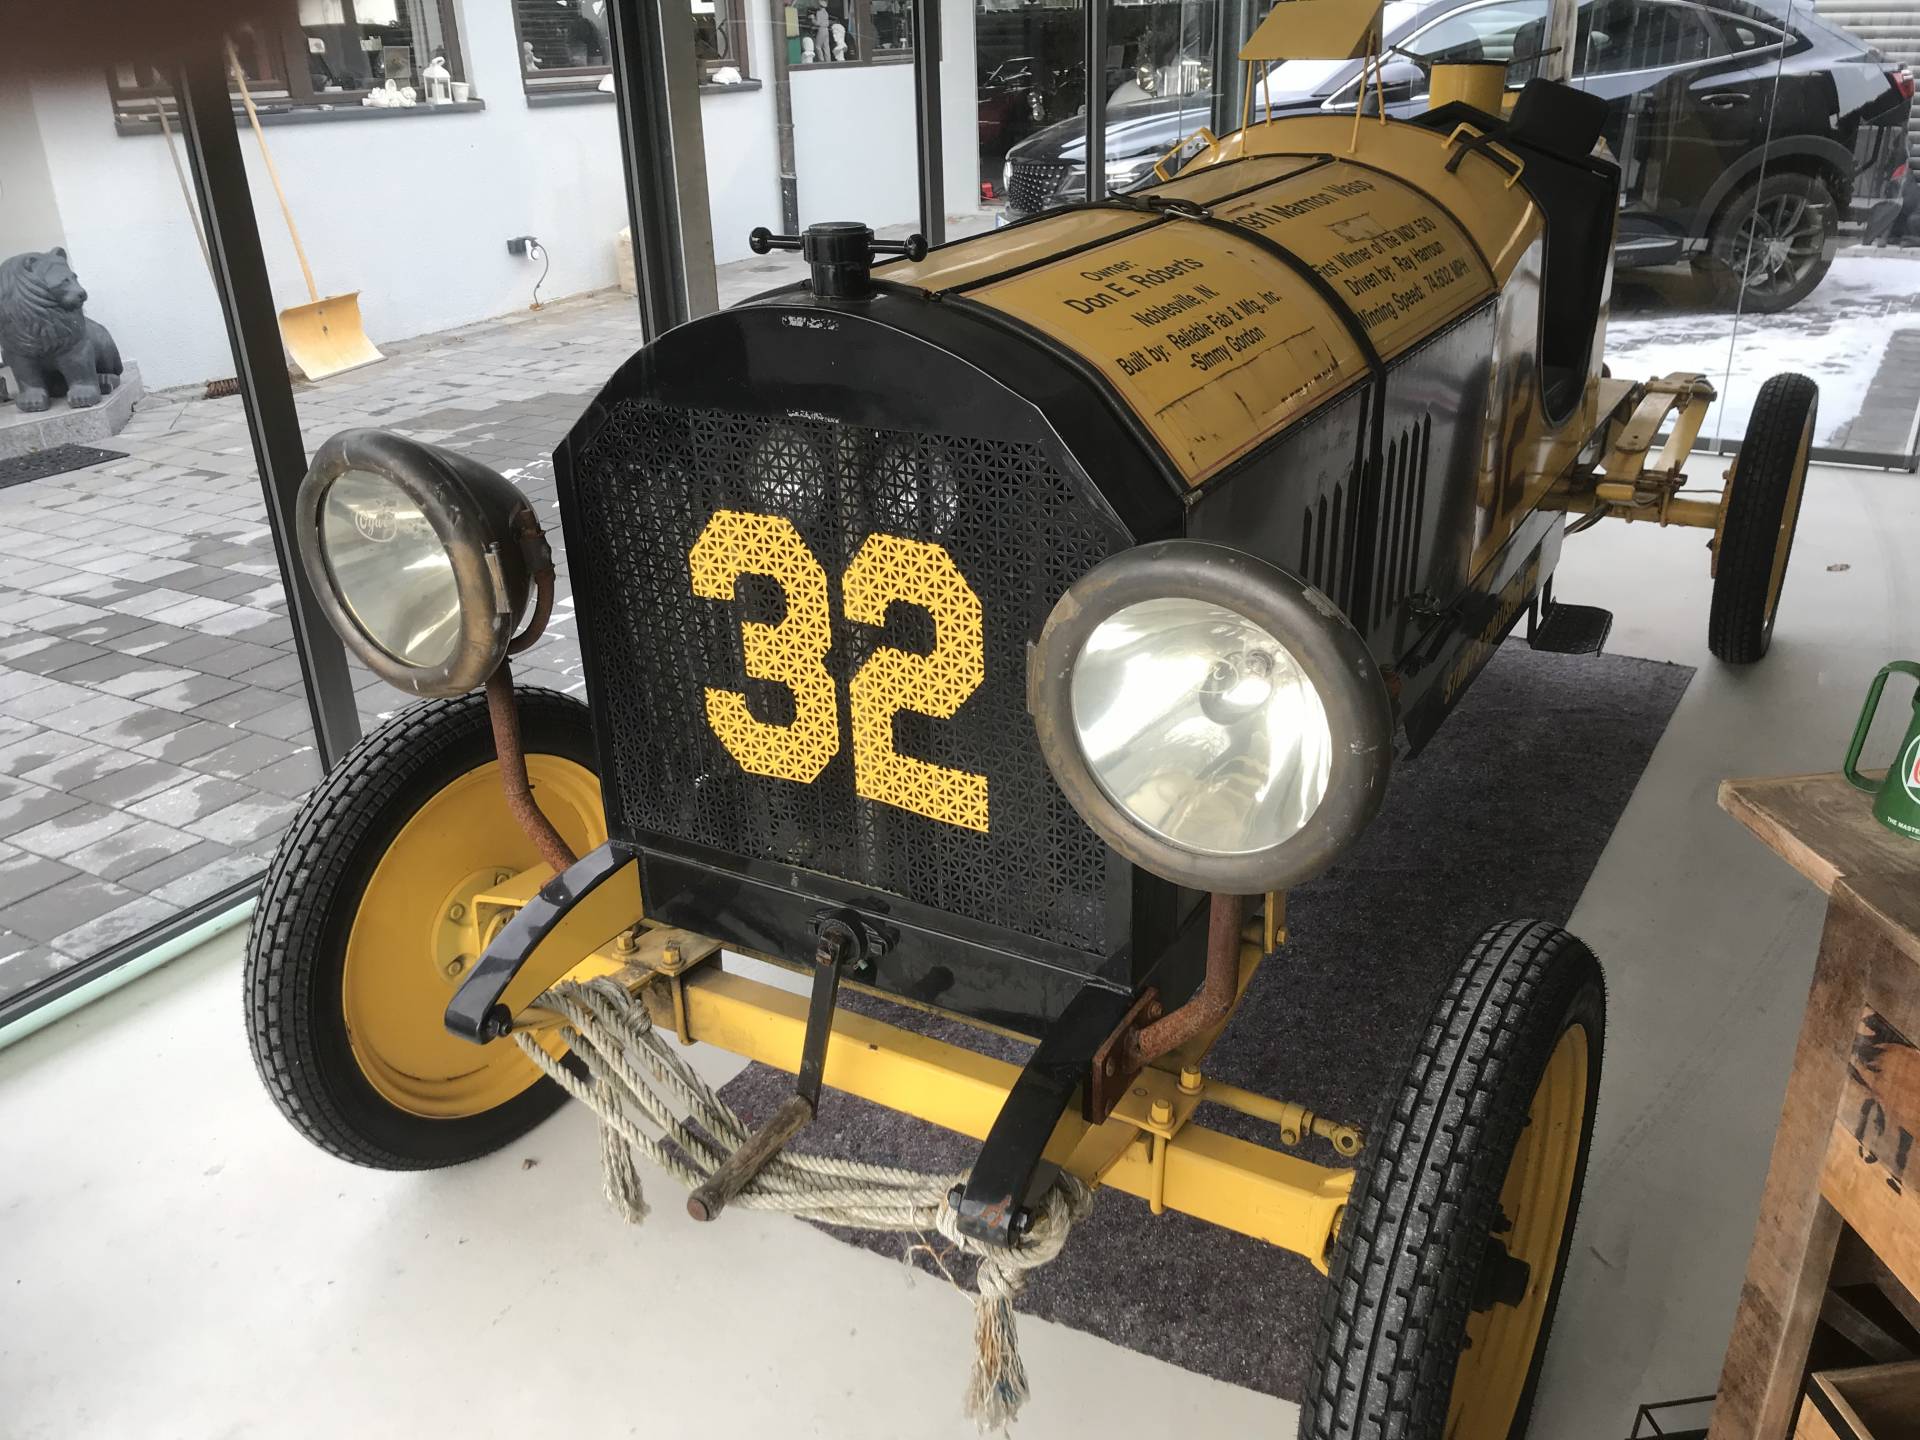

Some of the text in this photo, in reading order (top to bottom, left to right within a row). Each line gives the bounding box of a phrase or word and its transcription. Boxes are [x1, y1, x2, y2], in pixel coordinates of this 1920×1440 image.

[1264, 192, 1340, 219] Marmon
[1321, 180, 1377, 198] Wasp
[1333, 247, 1374, 269] Winner
[1371, 239, 1386, 254] of
[1379, 233, 1401, 249] the
[1413, 215, 1437, 235] 500
[1064, 258, 1204, 315] Don E. Roberts
[1080, 260, 1138, 283] Owner:
[1343, 275, 1382, 296] Driven
[1374, 264, 1397, 283] by:
[1391, 255, 1418, 272] Ray
[1130, 283, 1220, 328] Noblesville, IN.
[1392, 282, 1427, 314] Speed:
[1115, 350, 1153, 377] Built
[1143, 343, 1172, 364] by:
[1166, 320, 1215, 351] Reliable
[1206, 311, 1234, 331] Fab
[1226, 305, 1244, 321] &
[1257, 290, 1282, 305] Inc.
[1225, 326, 1267, 353] Gordon
[689, 510, 989, 833] 32
[1887, 815, 1897, 826] THE
